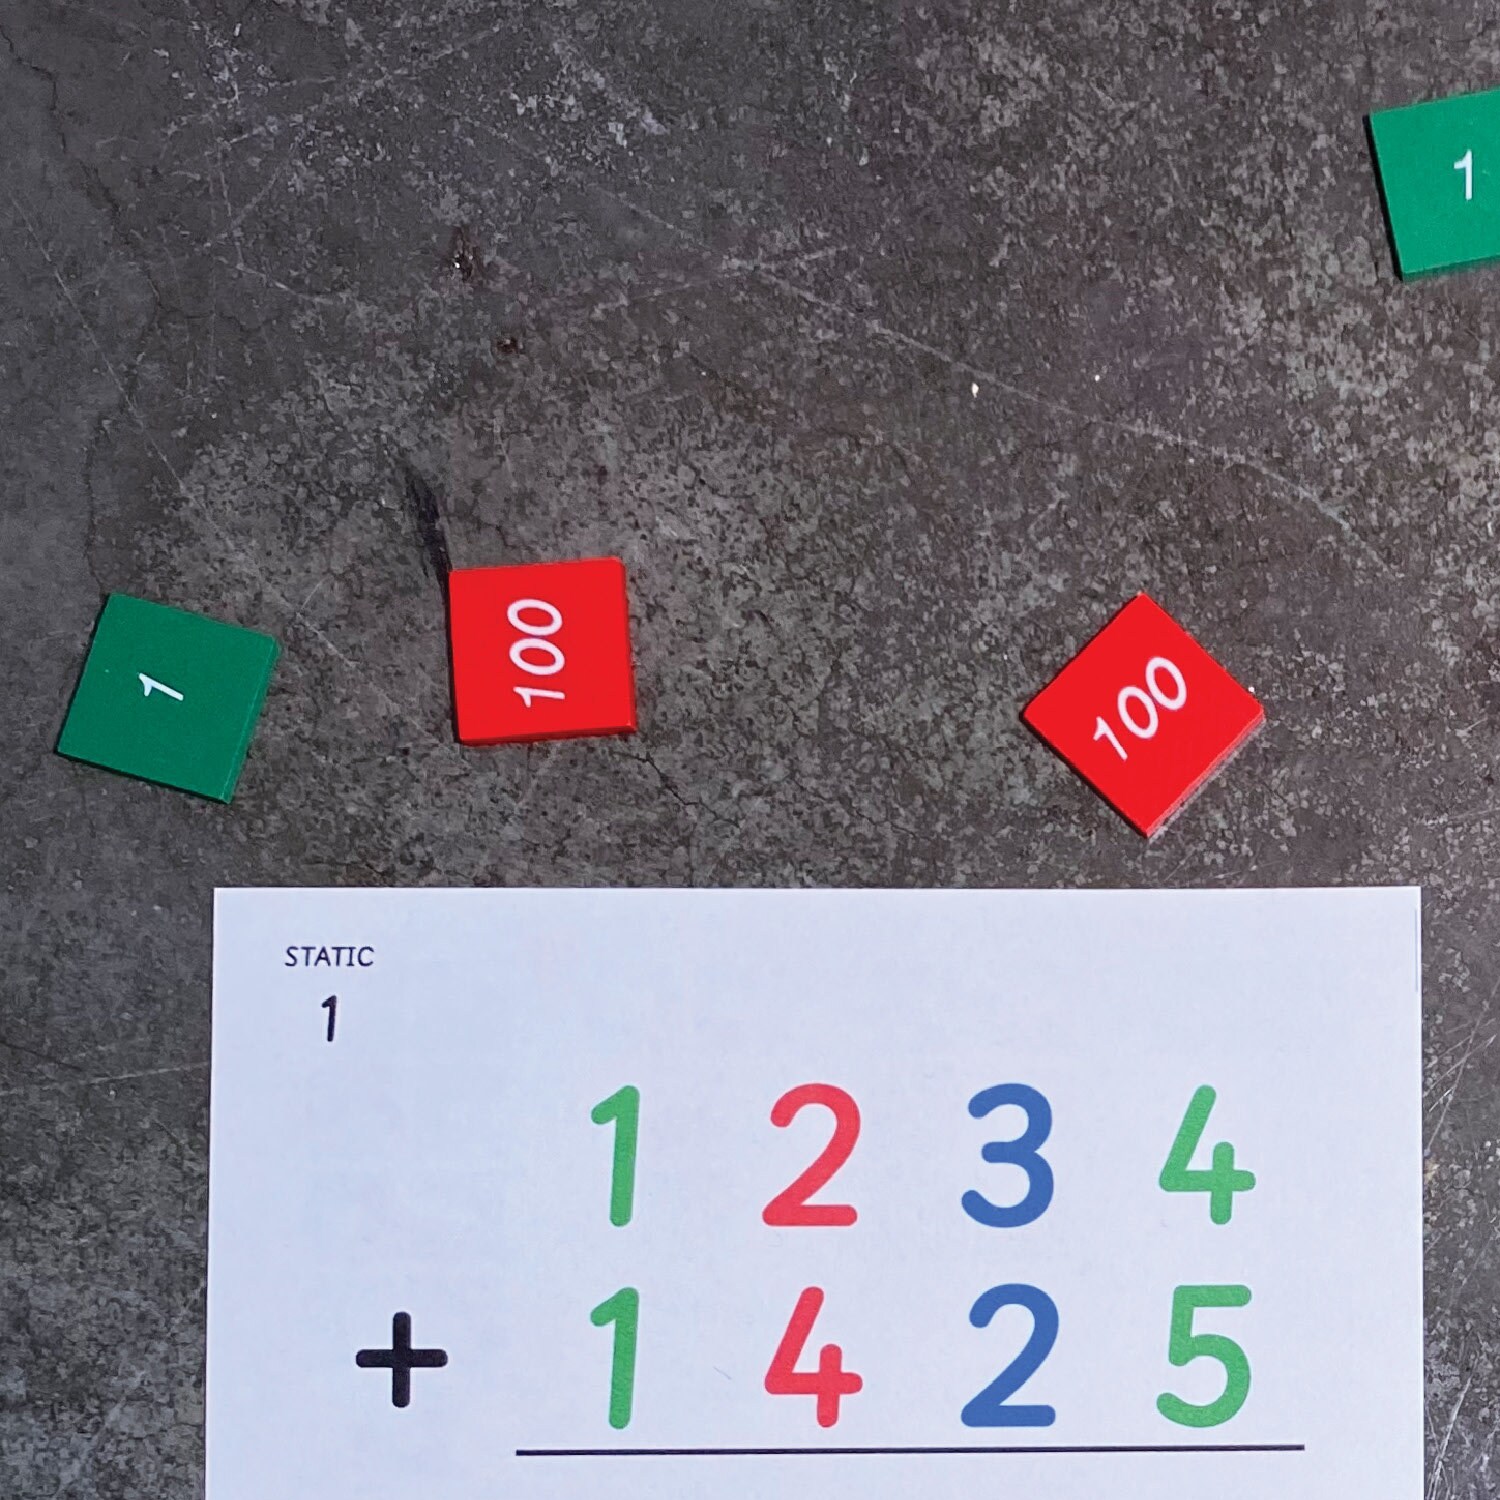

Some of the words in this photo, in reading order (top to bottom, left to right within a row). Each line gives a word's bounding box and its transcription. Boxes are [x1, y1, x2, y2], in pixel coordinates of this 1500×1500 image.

[1453, 151, 1473, 200] 1
[507, 599, 565, 706] 100
[138, 673, 184, 701] 1
[1093, 656, 1187, 760] 100
[284, 946, 374, 967] STATIC
[321, 995, 337, 1043] 1
